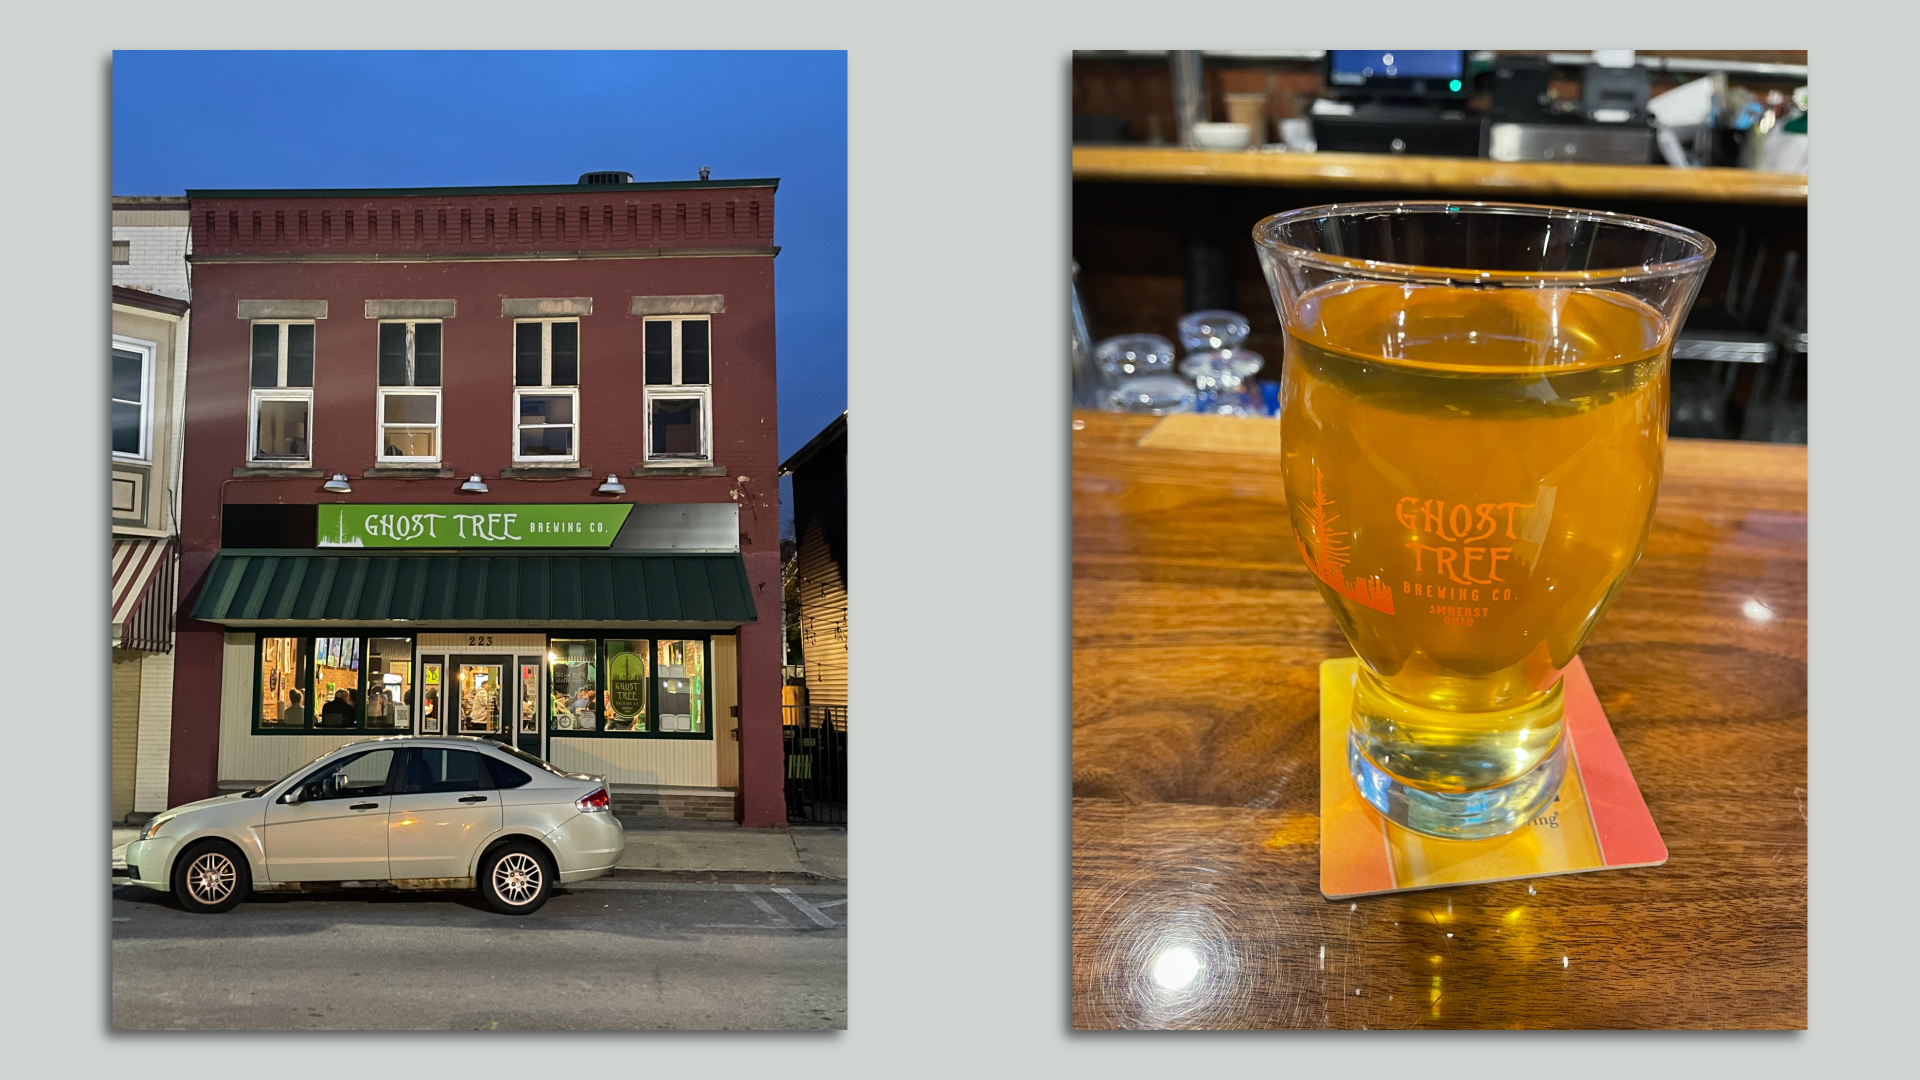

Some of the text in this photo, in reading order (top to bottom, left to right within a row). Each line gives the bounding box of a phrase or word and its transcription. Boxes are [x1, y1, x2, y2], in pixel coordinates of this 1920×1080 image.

[1396, 496, 1535, 543] GHOST
[365, 514, 608, 541] GHOST TREE BREWING CO.
[1404, 543, 1513, 585] TREE
[1403, 581, 1518, 602] BREWING CO.
[1429, 604, 1490, 618] AMHERST
[1443, 616, 1474, 627] OHIO
[469, 636, 493, 646] 223
[615, 682, 640, 691] GHOST
[617, 691, 638, 701] TREE
